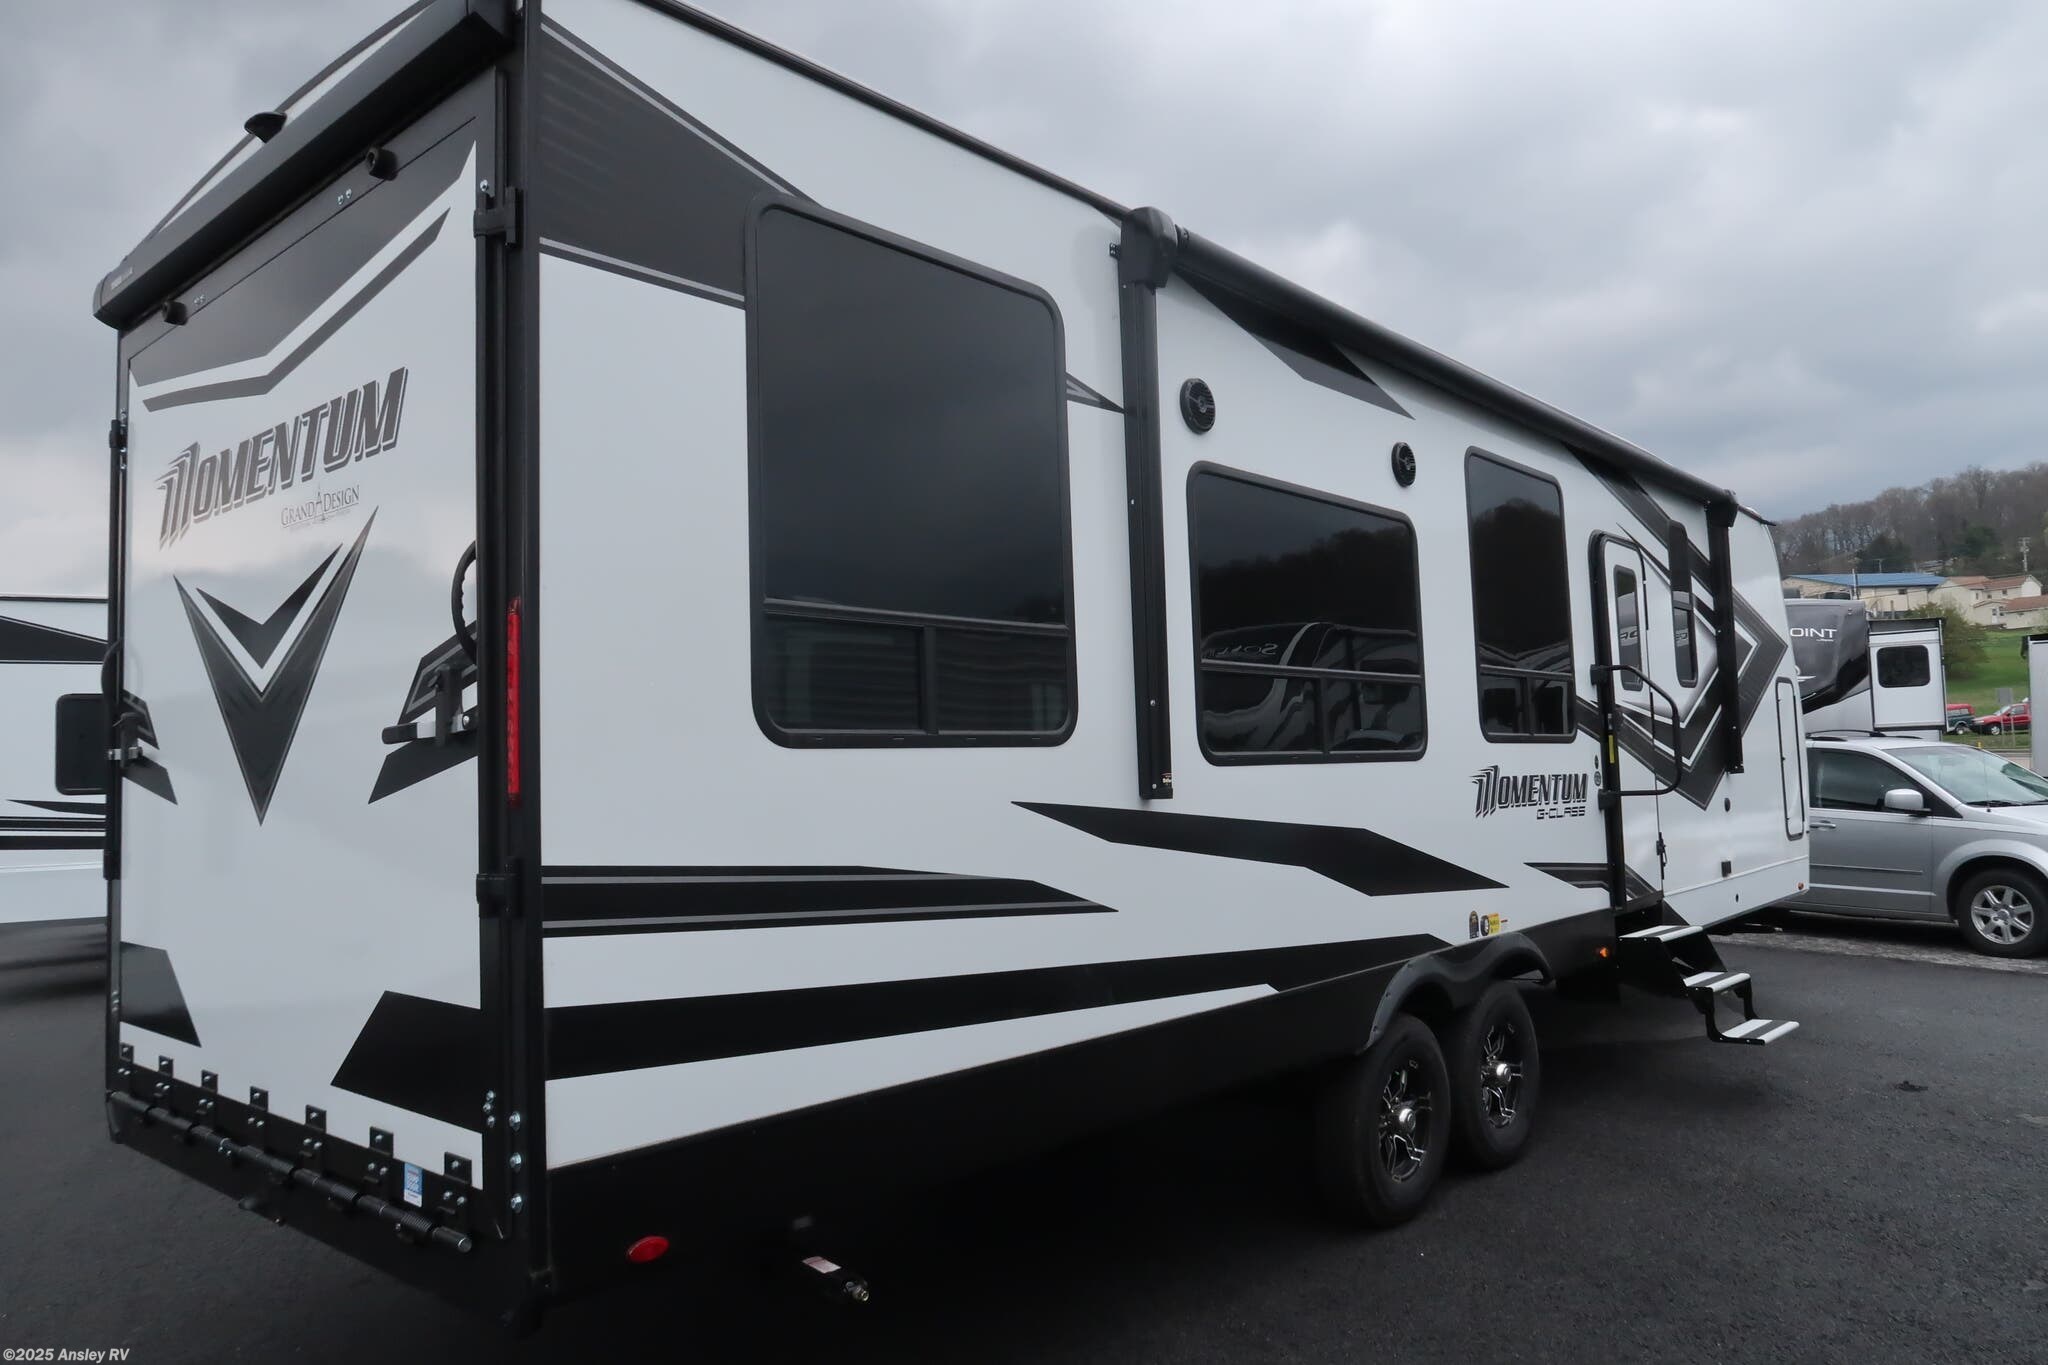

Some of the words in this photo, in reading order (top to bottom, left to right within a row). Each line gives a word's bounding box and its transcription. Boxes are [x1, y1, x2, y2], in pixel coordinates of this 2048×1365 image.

[155, 366, 409, 550] MOMENTUM
[281, 499, 315, 526] GRAND
[323, 484, 360, 512] DESIGN
[1470, 764, 1588, 818] MOMENTUM
[1536, 806, 1586, 820] G-CLASS
